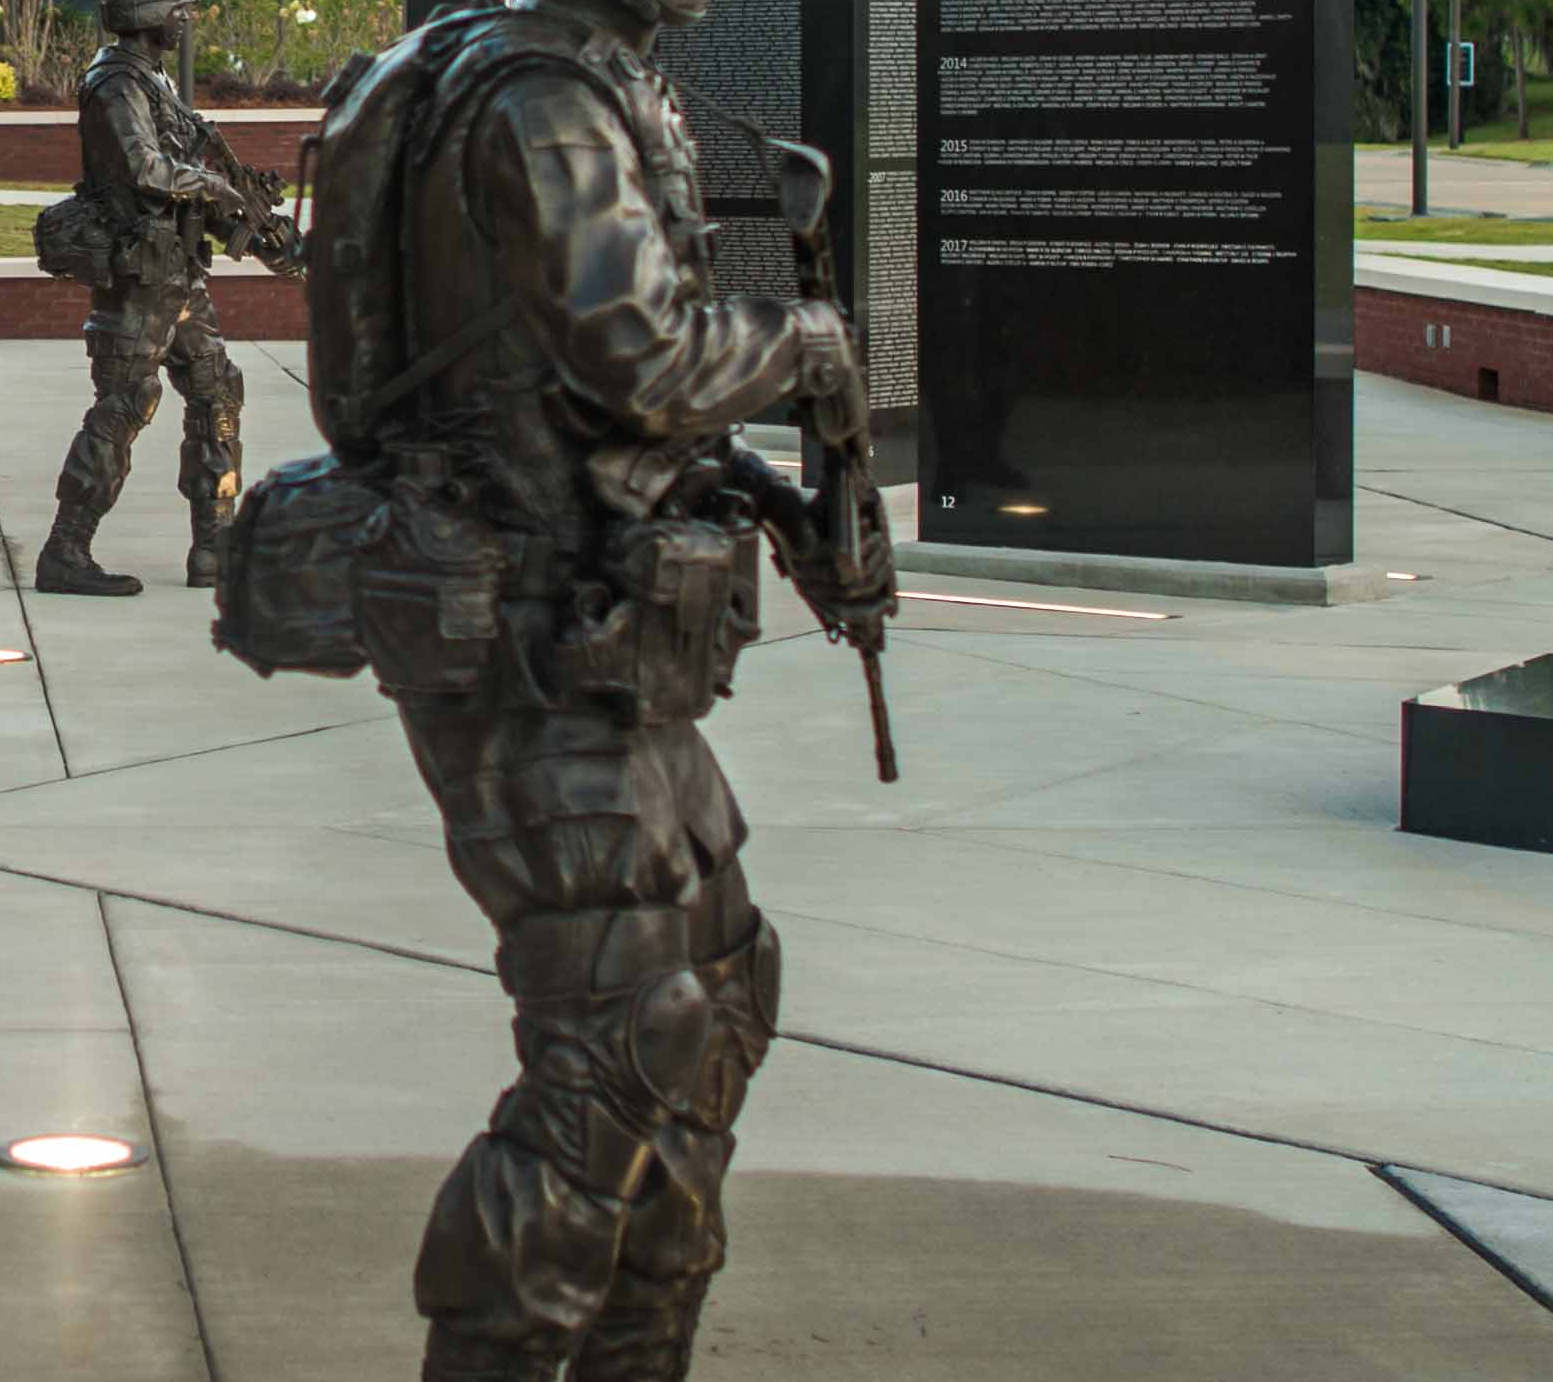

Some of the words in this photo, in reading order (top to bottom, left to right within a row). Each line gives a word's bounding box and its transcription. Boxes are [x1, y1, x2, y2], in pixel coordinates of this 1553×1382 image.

[940, 57, 967, 70] 2014
[940, 140, 968, 152] 2015
[940, 190, 968, 202] 2016
[940, 239, 968, 252] 2017
[941, 495, 956, 509] 12
